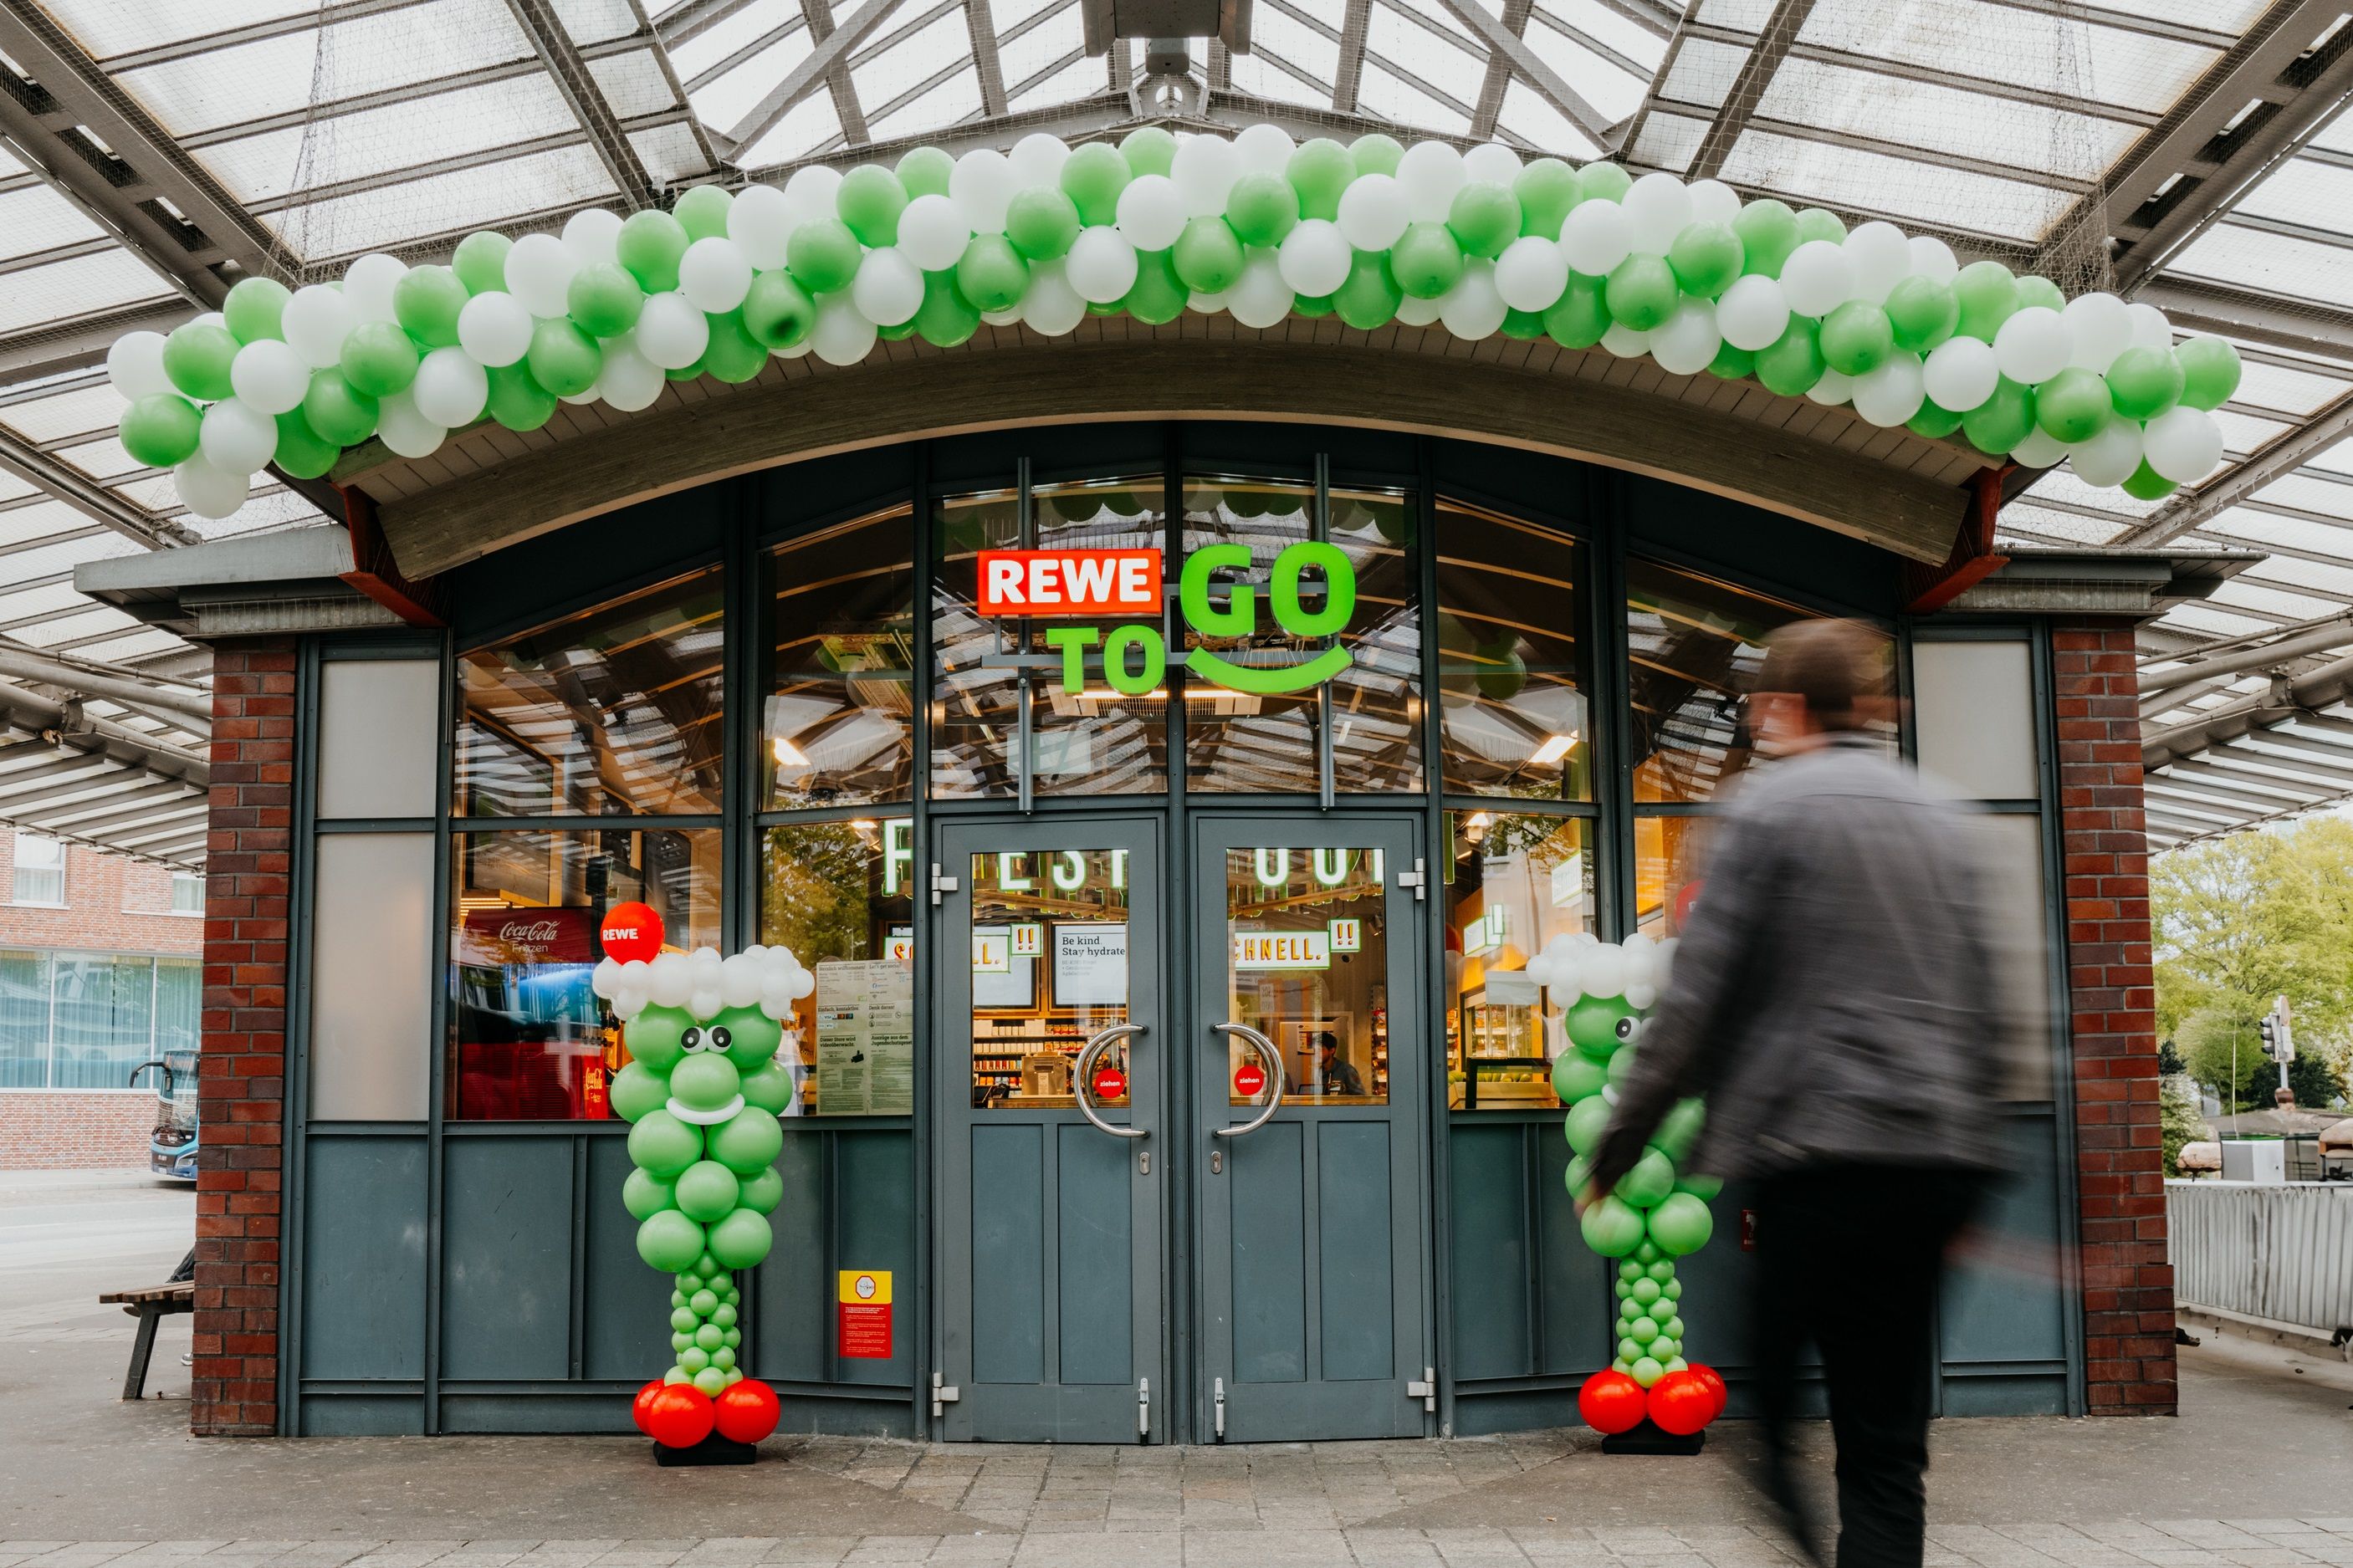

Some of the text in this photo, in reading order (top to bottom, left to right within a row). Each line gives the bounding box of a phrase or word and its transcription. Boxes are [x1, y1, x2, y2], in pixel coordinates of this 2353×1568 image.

[988, 558, 1151, 603] REWE
[1180, 541, 1356, 637] GO
[1046, 625, 1165, 695] TO
[499, 921, 561, 942] Coca-Cola
[602, 928, 638, 941] REWE
[1062, 937, 1074, 945] Be
[512, 943, 549, 953] Frozen
[1062, 947, 1126, 958] Stay hydrate
[1235, 938, 1322, 961] CHNELL.
